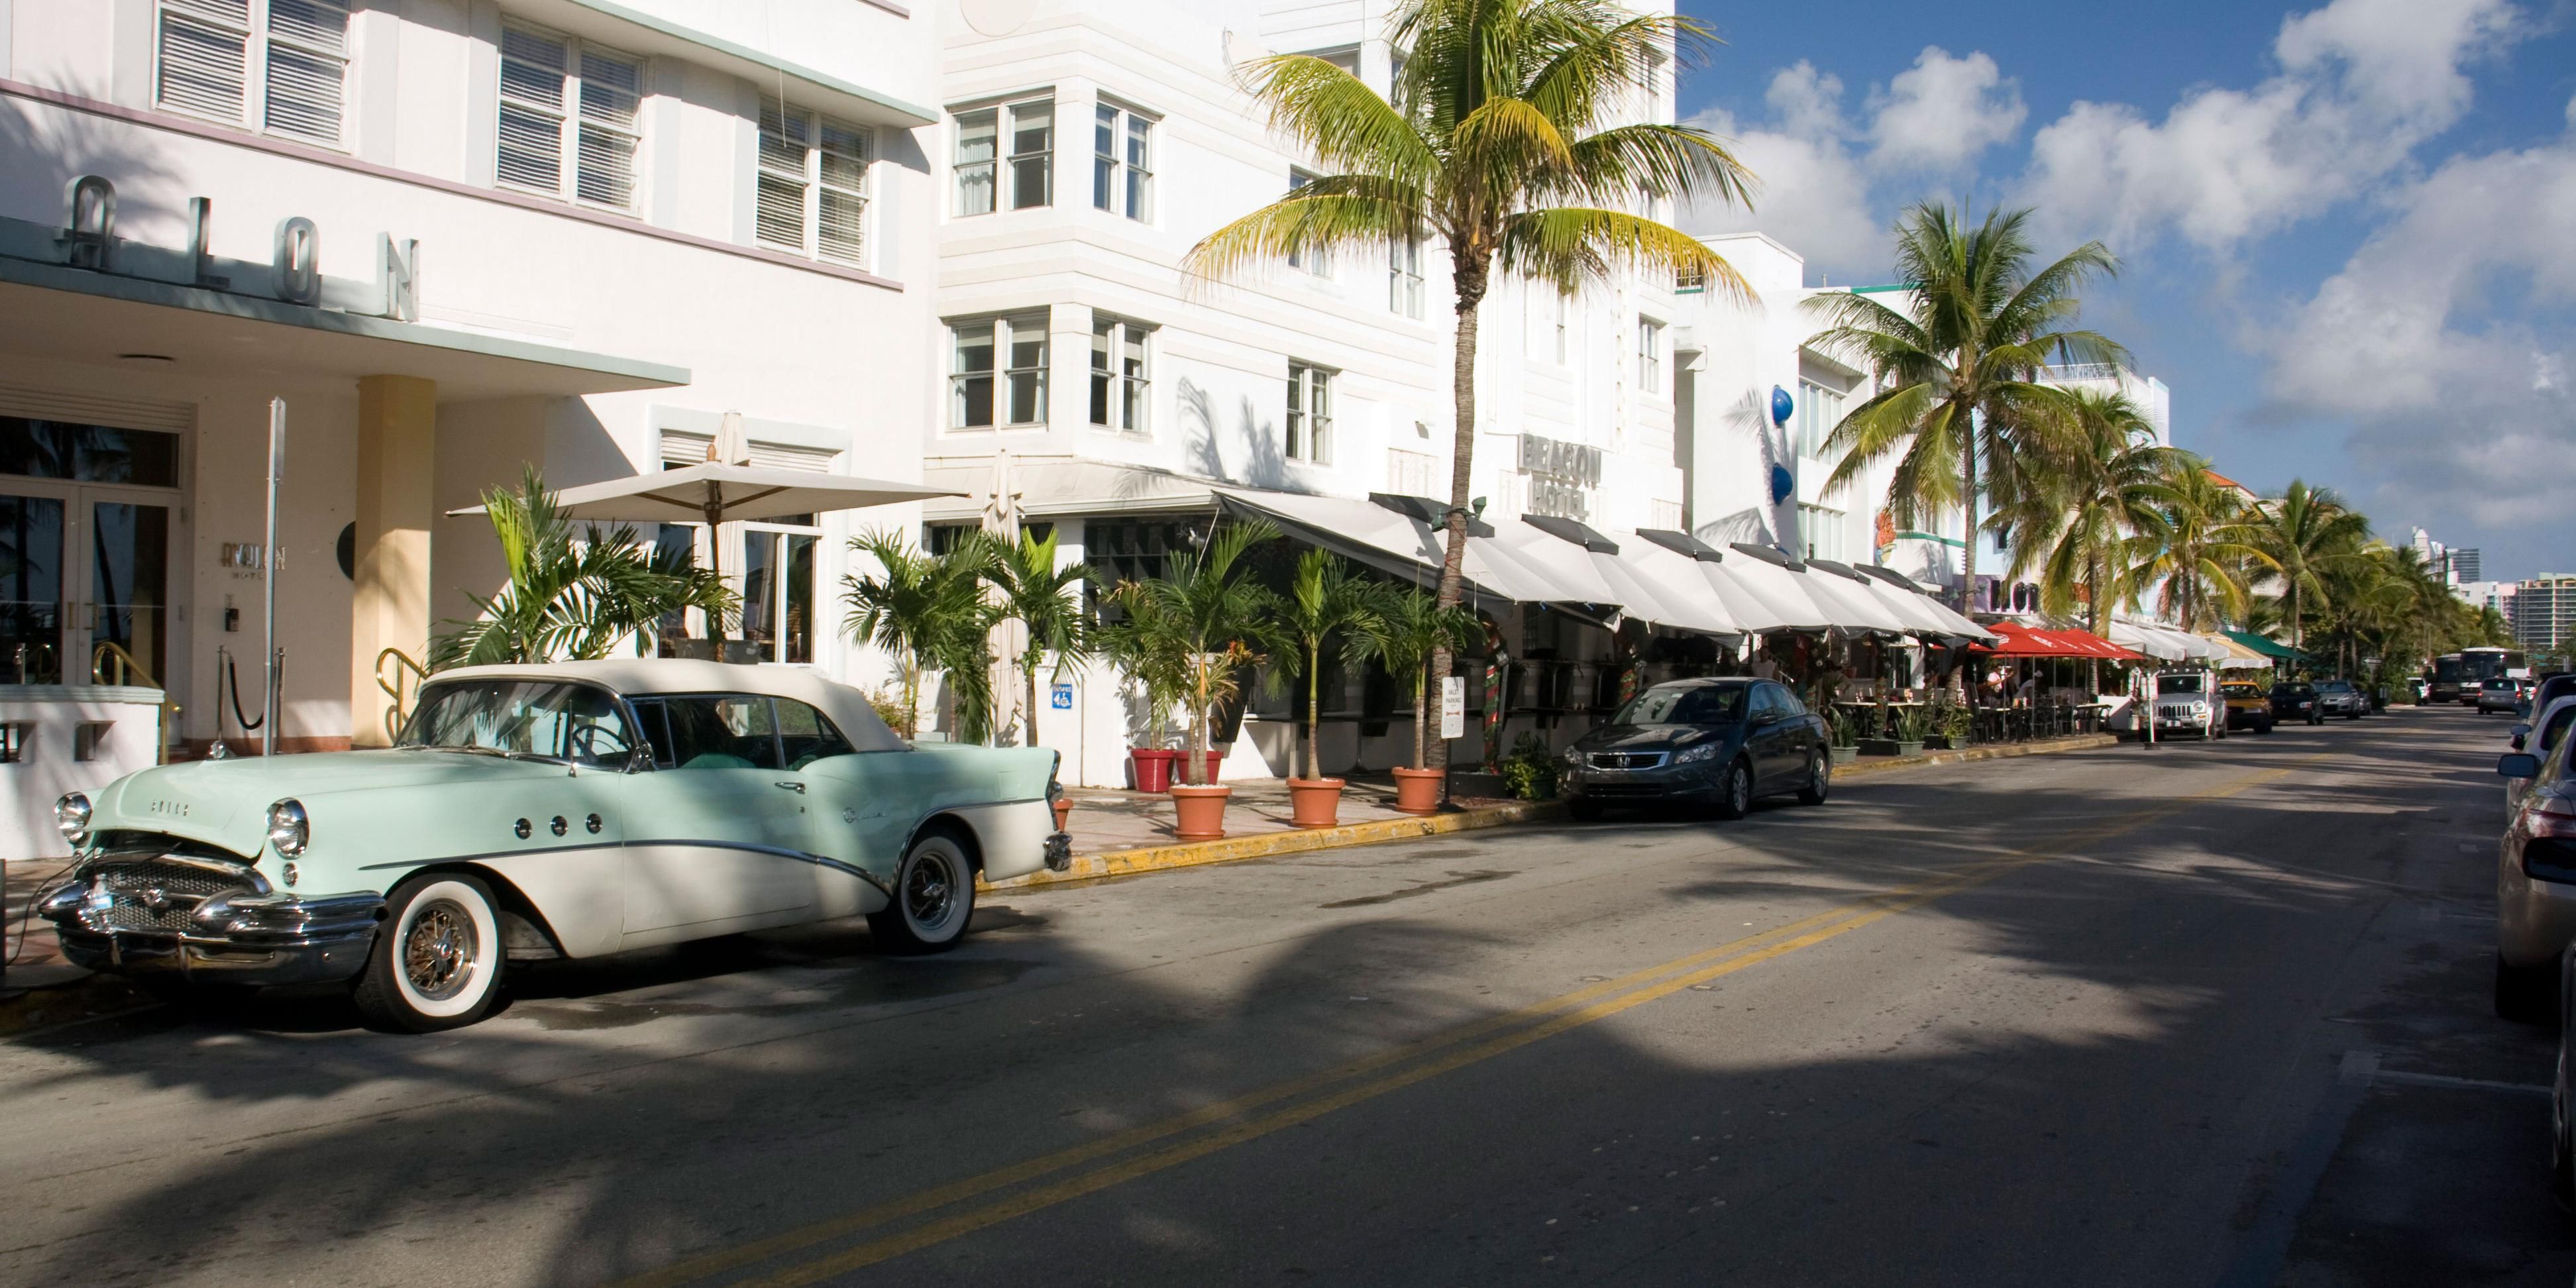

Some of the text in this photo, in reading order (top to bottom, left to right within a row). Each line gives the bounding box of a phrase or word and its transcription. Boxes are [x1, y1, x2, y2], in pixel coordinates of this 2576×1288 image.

[64, 174, 419, 323] ALON
[1517, 433, 1601, 484] BEACON
[1528, 481, 1590, 515] HOTEL
[221, 543, 286, 570] AVALN
